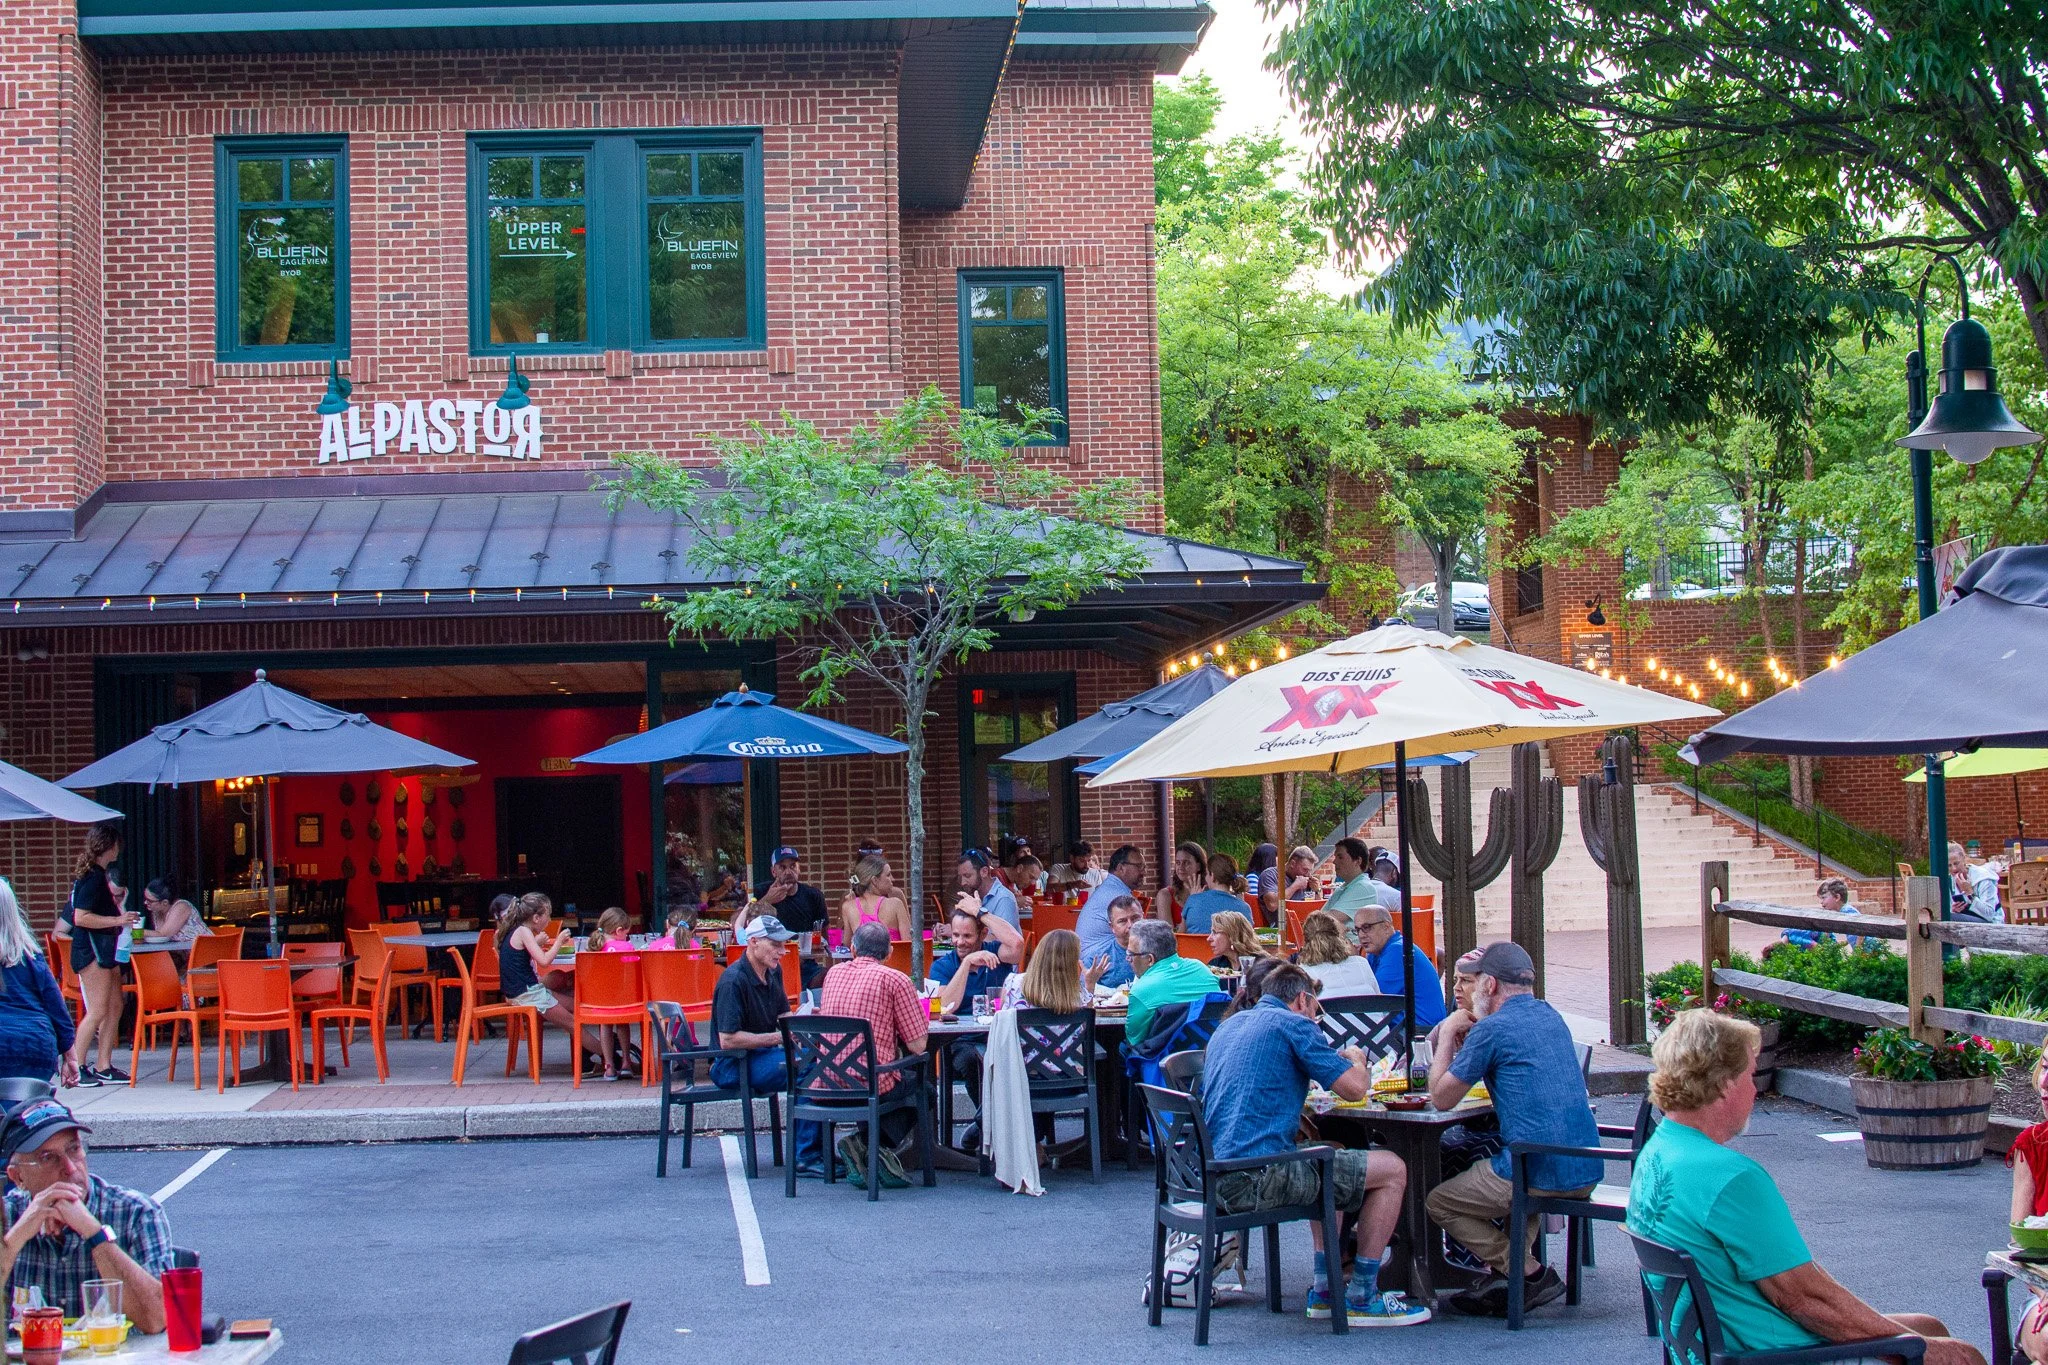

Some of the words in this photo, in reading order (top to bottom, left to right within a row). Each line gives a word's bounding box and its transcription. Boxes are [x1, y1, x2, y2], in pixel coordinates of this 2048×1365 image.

[506, 222, 562, 235] UPPER
[508, 237, 559, 250] LEVEL
[667, 240, 738, 252] BLUEFIN
[257, 246, 328, 258] BLUEFIN
[690, 252, 738, 260] EAGLEVIEW
[280, 258, 328, 266] EAGLEVIEW
[1302, 671, 1339, 682] DOS
[1341, 667, 1396, 682] EQUIS
[1254, 733, 1307, 752] Ambar
[1308, 722, 1370, 748] Especial
[728, 741, 824, 757] Corona
